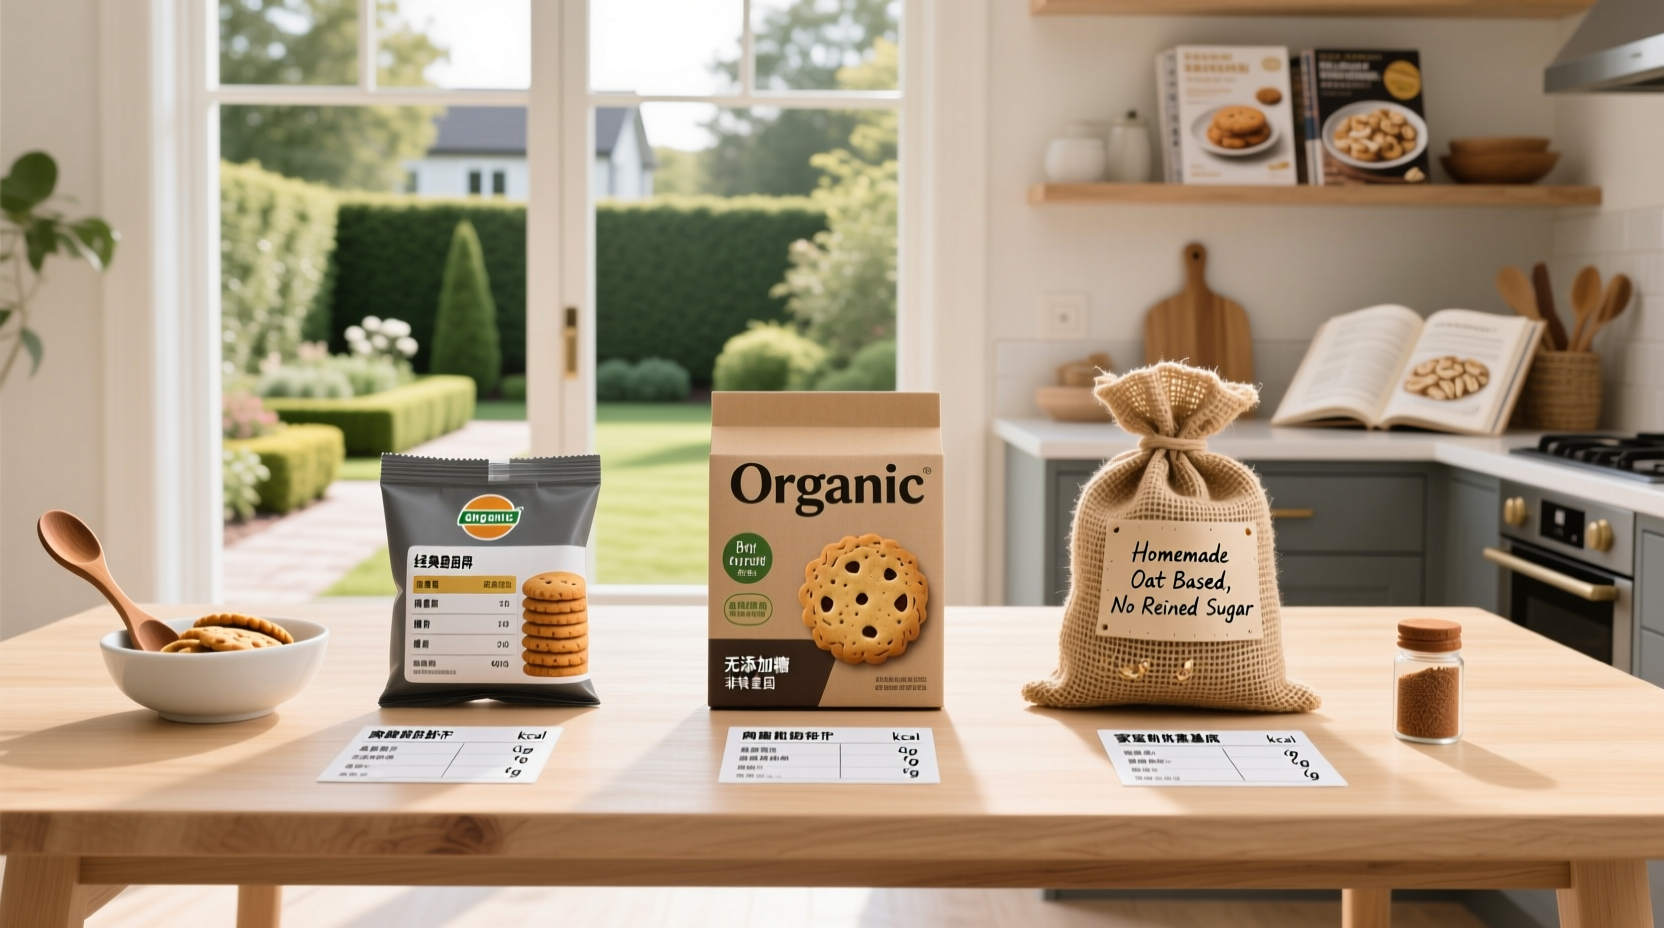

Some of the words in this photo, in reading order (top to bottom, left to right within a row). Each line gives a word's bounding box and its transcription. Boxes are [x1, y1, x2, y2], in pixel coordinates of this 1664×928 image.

[730, 462, 925, 517] Organic
[1132, 540, 1230, 563] Homemade
[1131, 569, 1167, 589] Oat
[1173, 570, 1231, 594] Based,
[1110, 594, 1135, 614] No
[1141, 596, 1200, 616] Reined
[1206, 598, 1254, 623] Sugar
